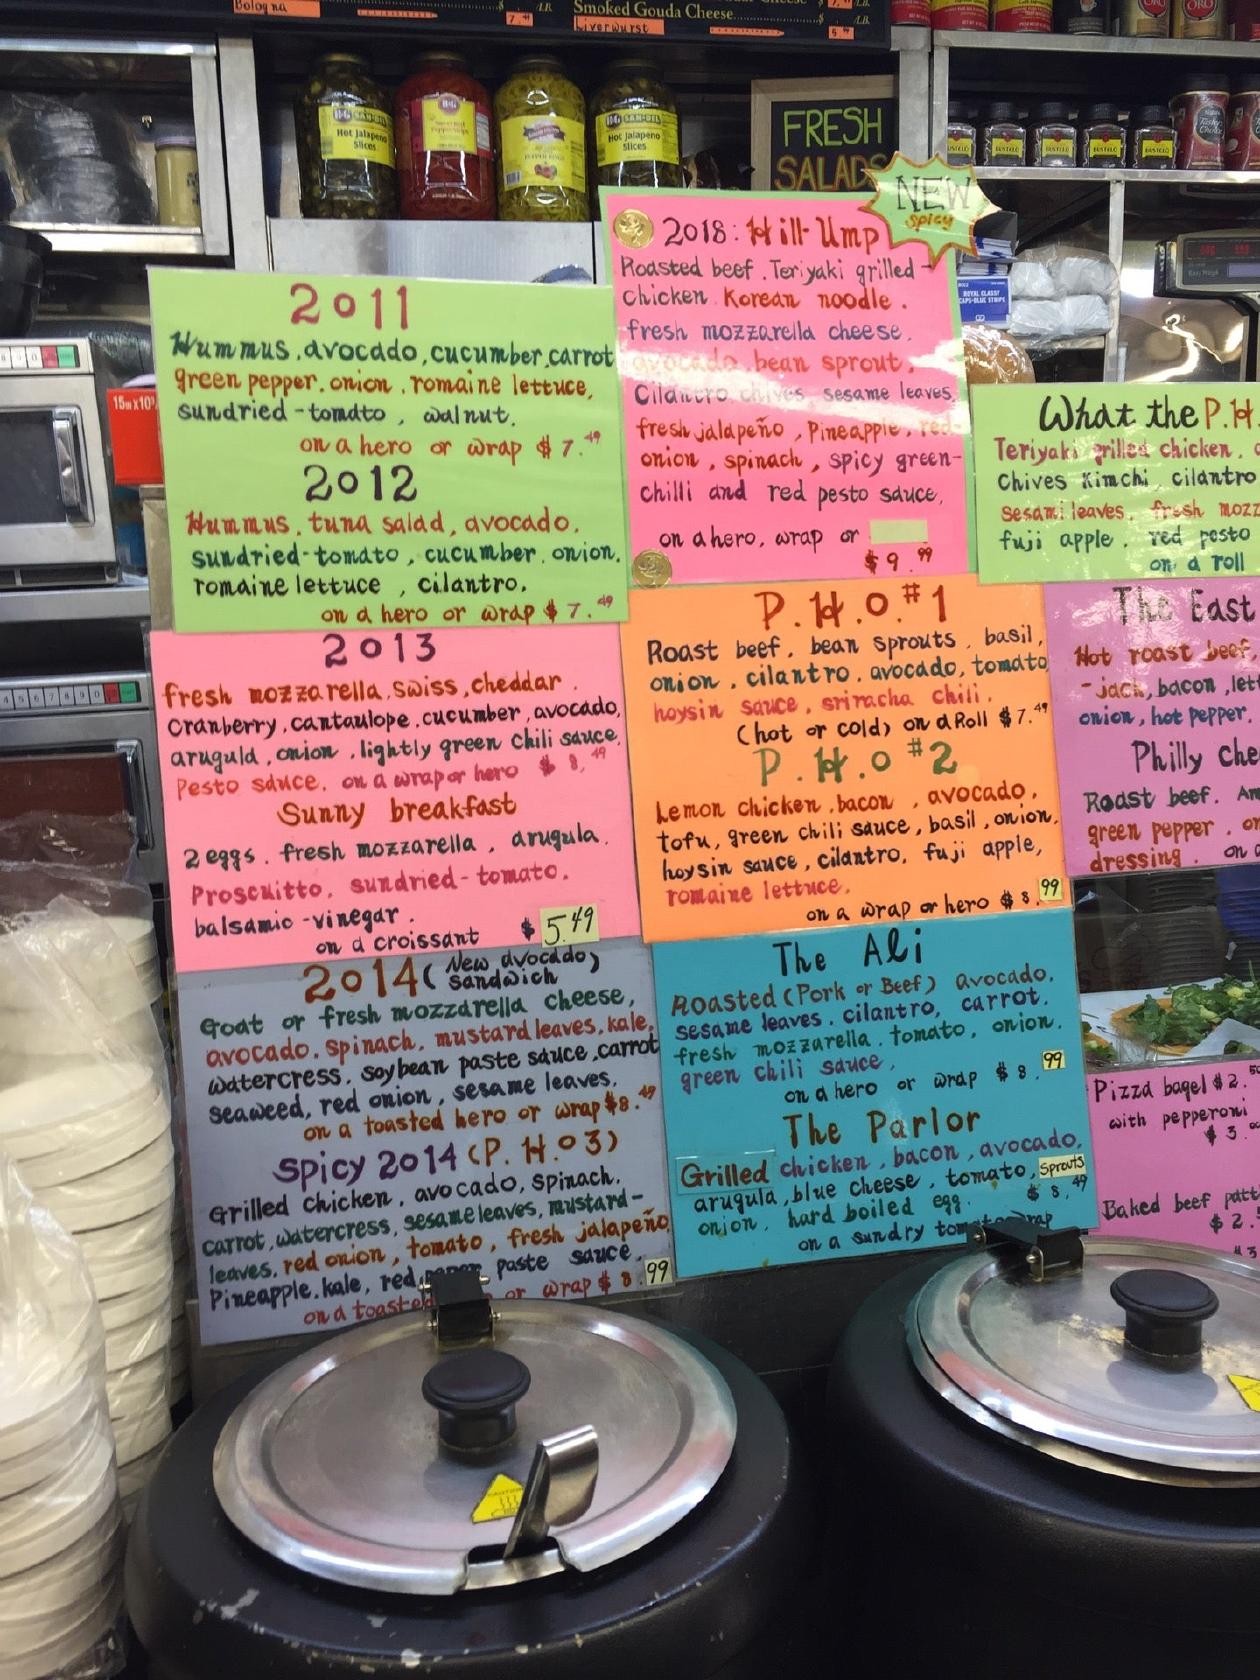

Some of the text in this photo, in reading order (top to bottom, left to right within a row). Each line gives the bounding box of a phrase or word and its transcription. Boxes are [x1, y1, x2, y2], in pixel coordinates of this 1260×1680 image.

[574, 0, 630, 17] Smoked
[634, 1, 682, 19] Gouda
[685, 3, 734, 21] Cheese
[575, 15, 650, 34] Liverwurst
[336, 128, 353, 138] Hot
[608, 133, 622, 143] Hot
[783, 106, 882, 148] FRESH
[896, 175, 972, 212] NEW
[620, 256, 703, 277] Roasted
[769, 259, 843, 285] Teriyaki
[291, 283, 408, 330] 2011
[627, 319, 688, 341] fresh
[702, 320, 815, 341] mozzarella
[549, 344, 614, 367] carrot
[175, 368, 241, 394] green
[410, 369, 501, 394] romaine
[1040, 395, 1136, 431] What
[1146, 395, 1199, 429] the
[994, 437, 1077, 466] Teriyaki
[1089, 438, 1150, 466] grilled
[304, 465, 417, 502] 2012
[1172, 466, 1256, 486] cilantro
[640, 480, 692, 503] chilli
[709, 479, 747, 501] and
[767, 479, 807, 502] red
[818, 485, 868, 511] pesto
[999, 530, 1042, 552] fuji
[1149, 525, 1182, 546] red
[1200, 526, 1250, 549] pesto
[1113, 586, 1255, 625] The East
[323, 633, 436, 668] 2013
[647, 640, 718, 665] Roast
[811, 636, 859, 655] bean
[1074, 644, 1112, 666] Hot
[1128, 639, 1193, 665] roast
[163, 682, 232, 708] fresh
[1152, 706, 1183, 725] hot
[1131, 740, 1202, 775] Philly
[277, 792, 517, 829] Sunny breakfast
[656, 801, 725, 825] Lemon
[1083, 787, 1155, 813] Roast
[1088, 820, 1214, 848] green pepper
[807, 893, 989, 921] on a wrap or hero
[316, 926, 479, 954] on a croissant
[772, 928, 921, 976] The Ali
[303, 956, 418, 1004] 2014
[449, 967, 558, 990] sandwich
[672, 983, 776, 1016] Roasted
[856, 983, 872, 996] or
[200, 1015, 263, 1039] Goat
[282, 1015, 305, 1032] or
[319, 1004, 381, 1029] fresh
[391, 997, 528, 1022] mozzarella
[1095, 1074, 1206, 1102] Pizza bagel
[783, 1107, 980, 1149] The Parlor
[1109, 1098, 1247, 1131] with pepperoni
[378, 1142, 456, 1180] 2014
[681, 1160, 769, 1188] Grilled
[1040, 1156, 1085, 1177] Sprouts
[209, 1195, 289, 1225] Grilled
[1102, 1192, 1211, 1221] Baked beef
